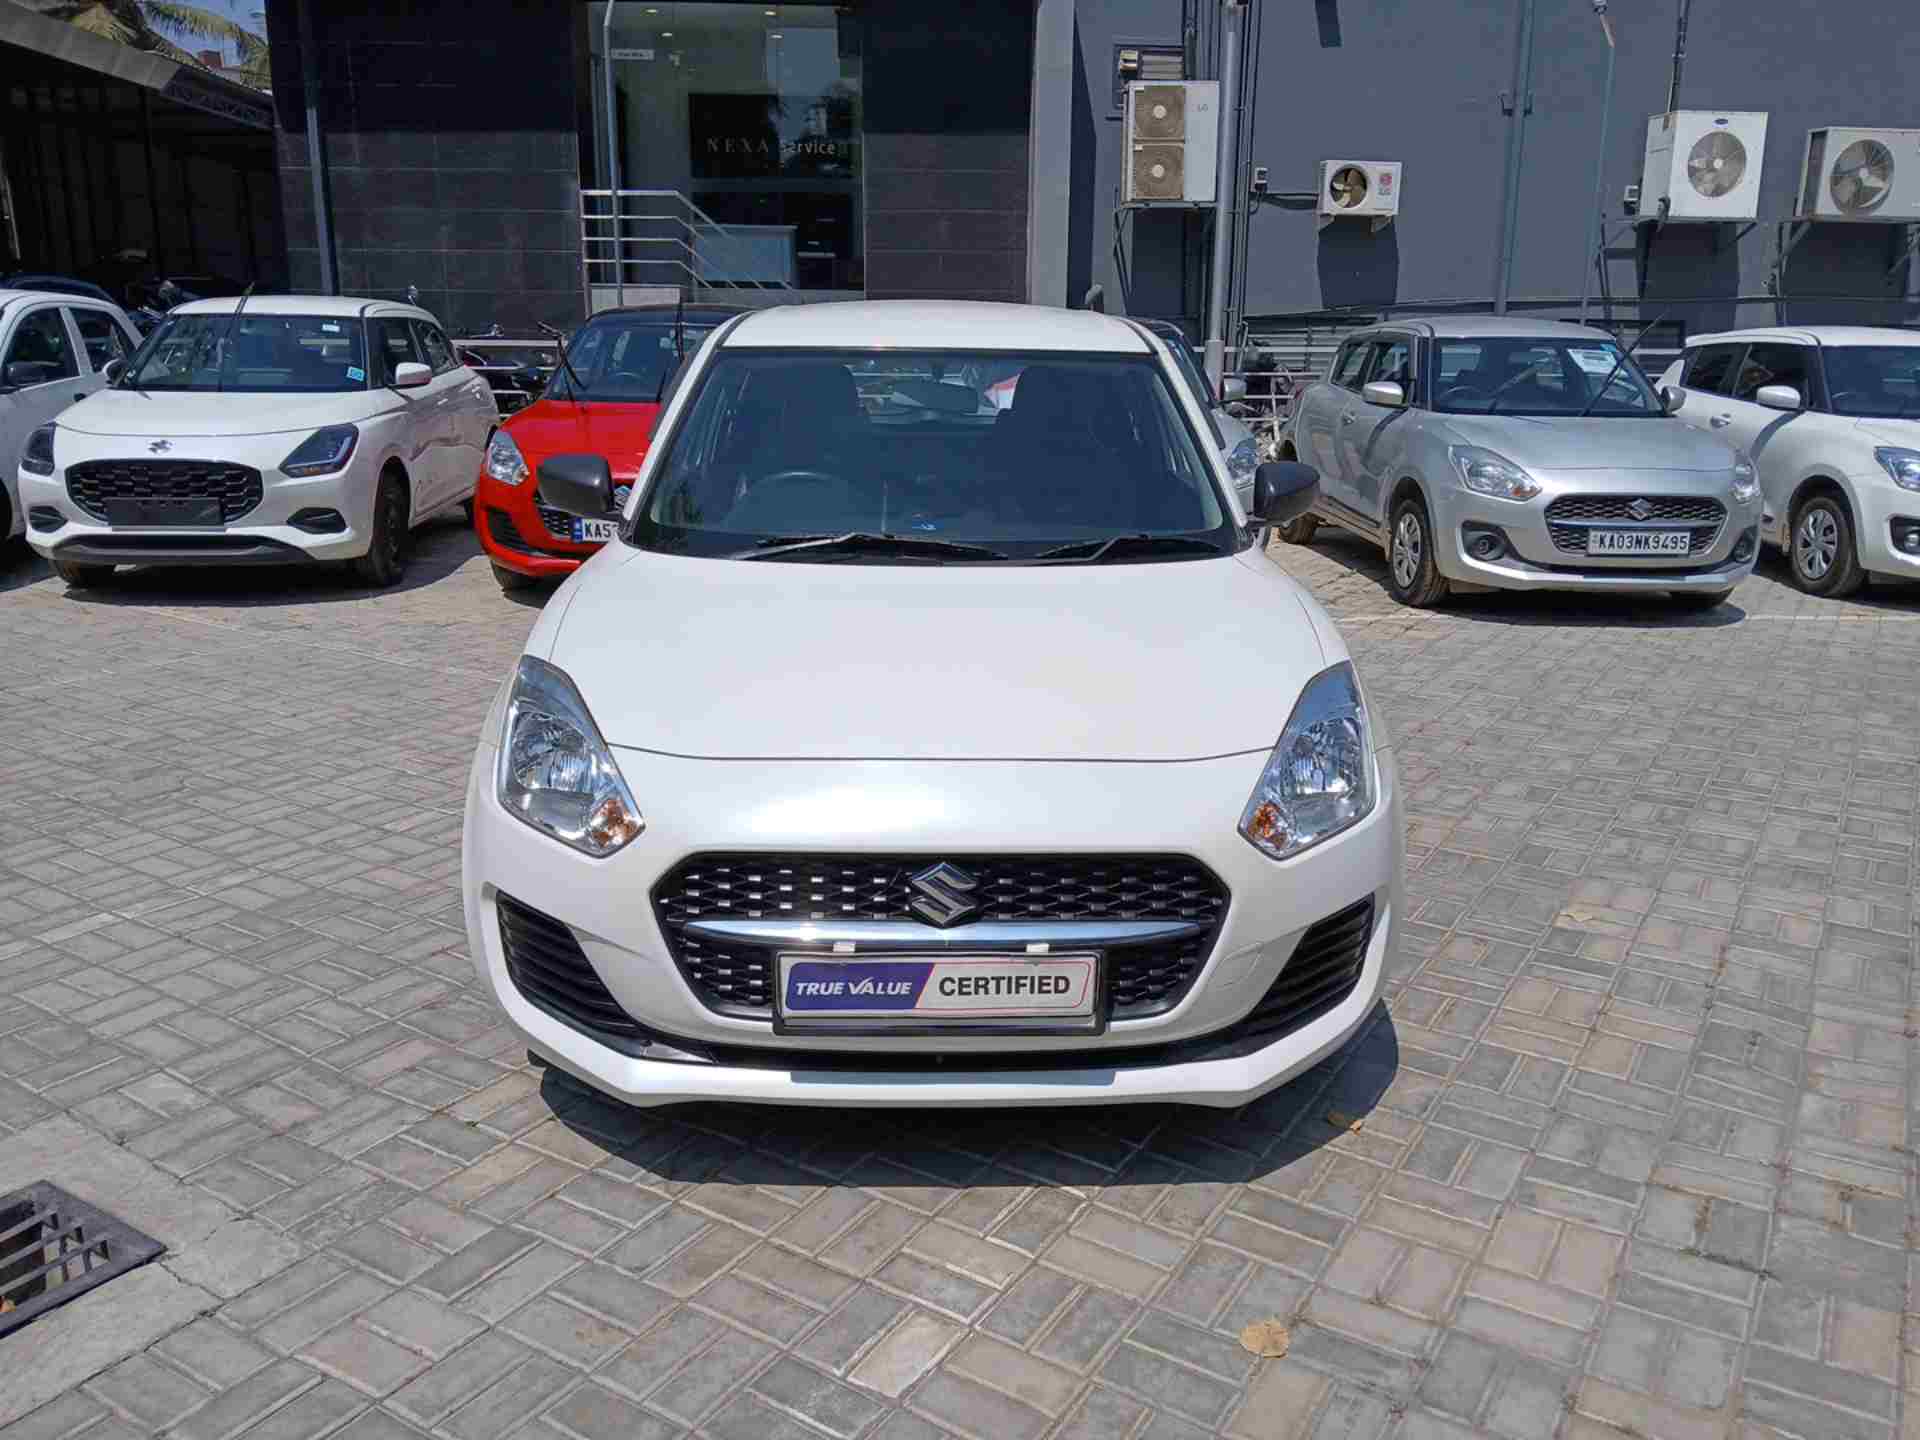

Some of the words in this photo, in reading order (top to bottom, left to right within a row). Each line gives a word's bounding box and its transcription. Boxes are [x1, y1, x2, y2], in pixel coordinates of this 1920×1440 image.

[706, 136, 769, 153] NEXA
[795, 982, 843, 996] TRUE
[847, 977, 912, 995] VALUE
[938, 975, 1070, 996] CERTIFIED
